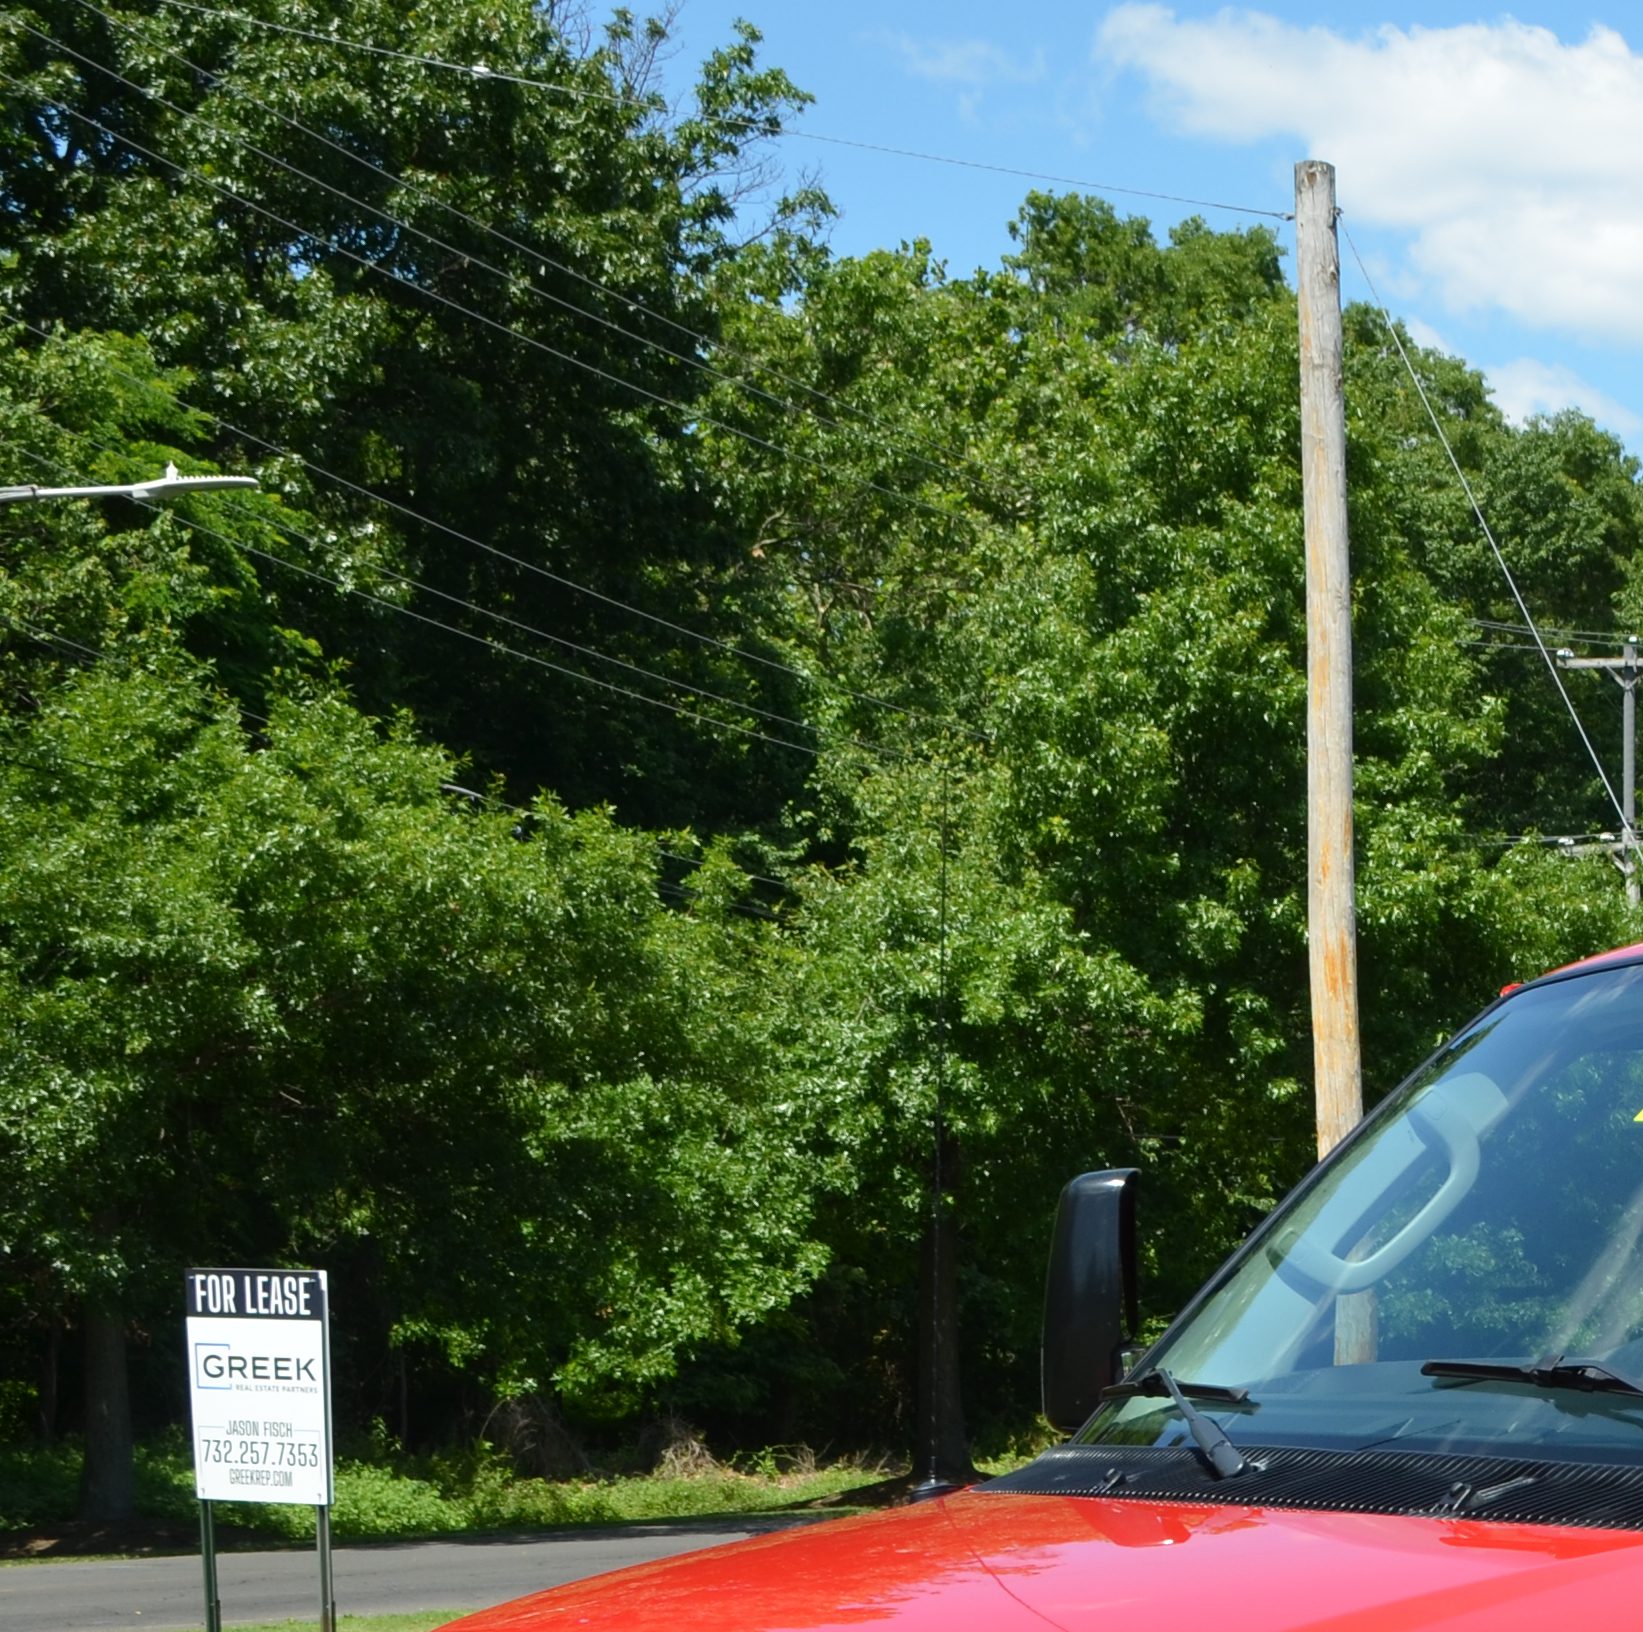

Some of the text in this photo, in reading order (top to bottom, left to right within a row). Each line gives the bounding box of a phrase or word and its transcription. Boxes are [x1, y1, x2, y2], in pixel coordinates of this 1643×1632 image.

[194, 1273, 311, 1316] FOR LEASE
[203, 1354, 317, 1382] GREEK
[235, 1384, 318, 1394] REAL ESTATE PARTNERS
[226, 1420, 293, 1438] JASON FISCH
[202, 1439, 318, 1467] 732.257.7353
[229, 1468, 293, 1487] GREEKREP.COM
